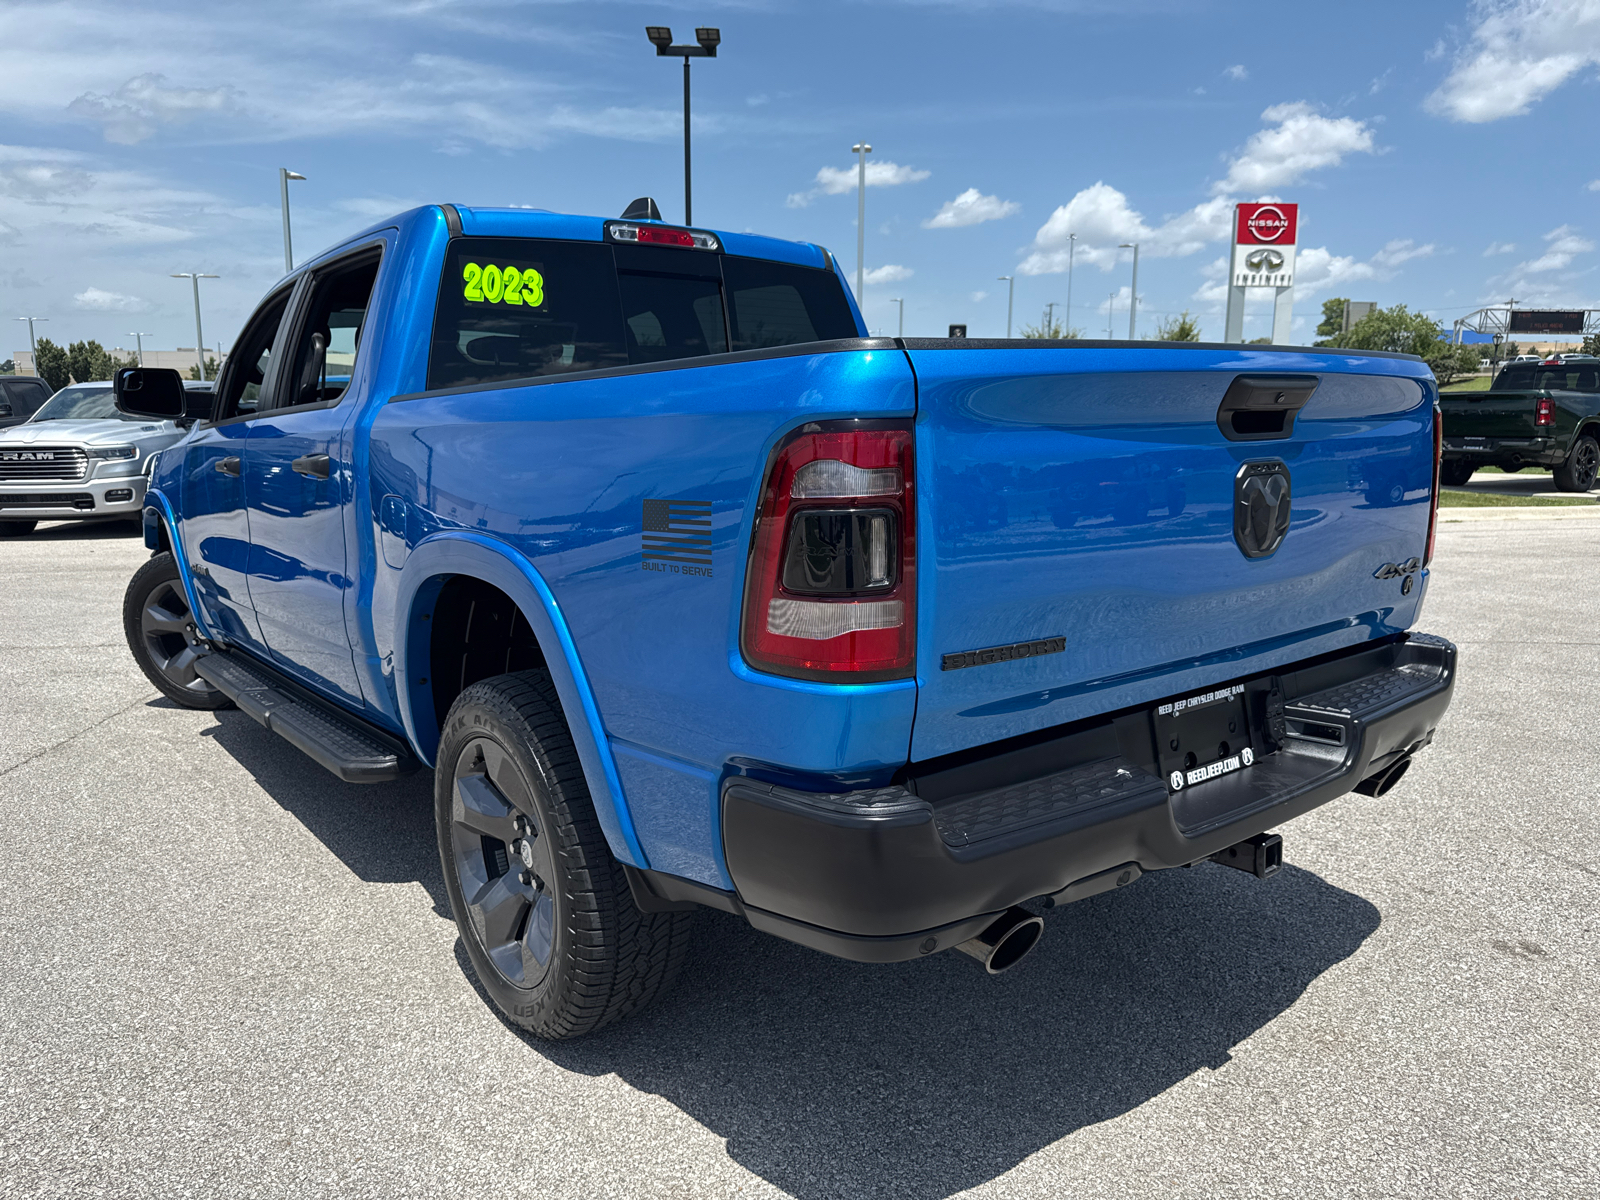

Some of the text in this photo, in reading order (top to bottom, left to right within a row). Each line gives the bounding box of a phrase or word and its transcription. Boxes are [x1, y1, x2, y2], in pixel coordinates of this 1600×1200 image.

[1248, 219, 1288, 227] NISSAN
[463, 262, 544, 307] 2023
[3, 453, 55, 461] RAM
[642, 562, 713, 578] BUILT TO SERVE
[1158, 683, 1245, 716] REED JEEP CHRYSLER DODGE RAM
[1187, 756, 1241, 785] REEDJEEP.COM
